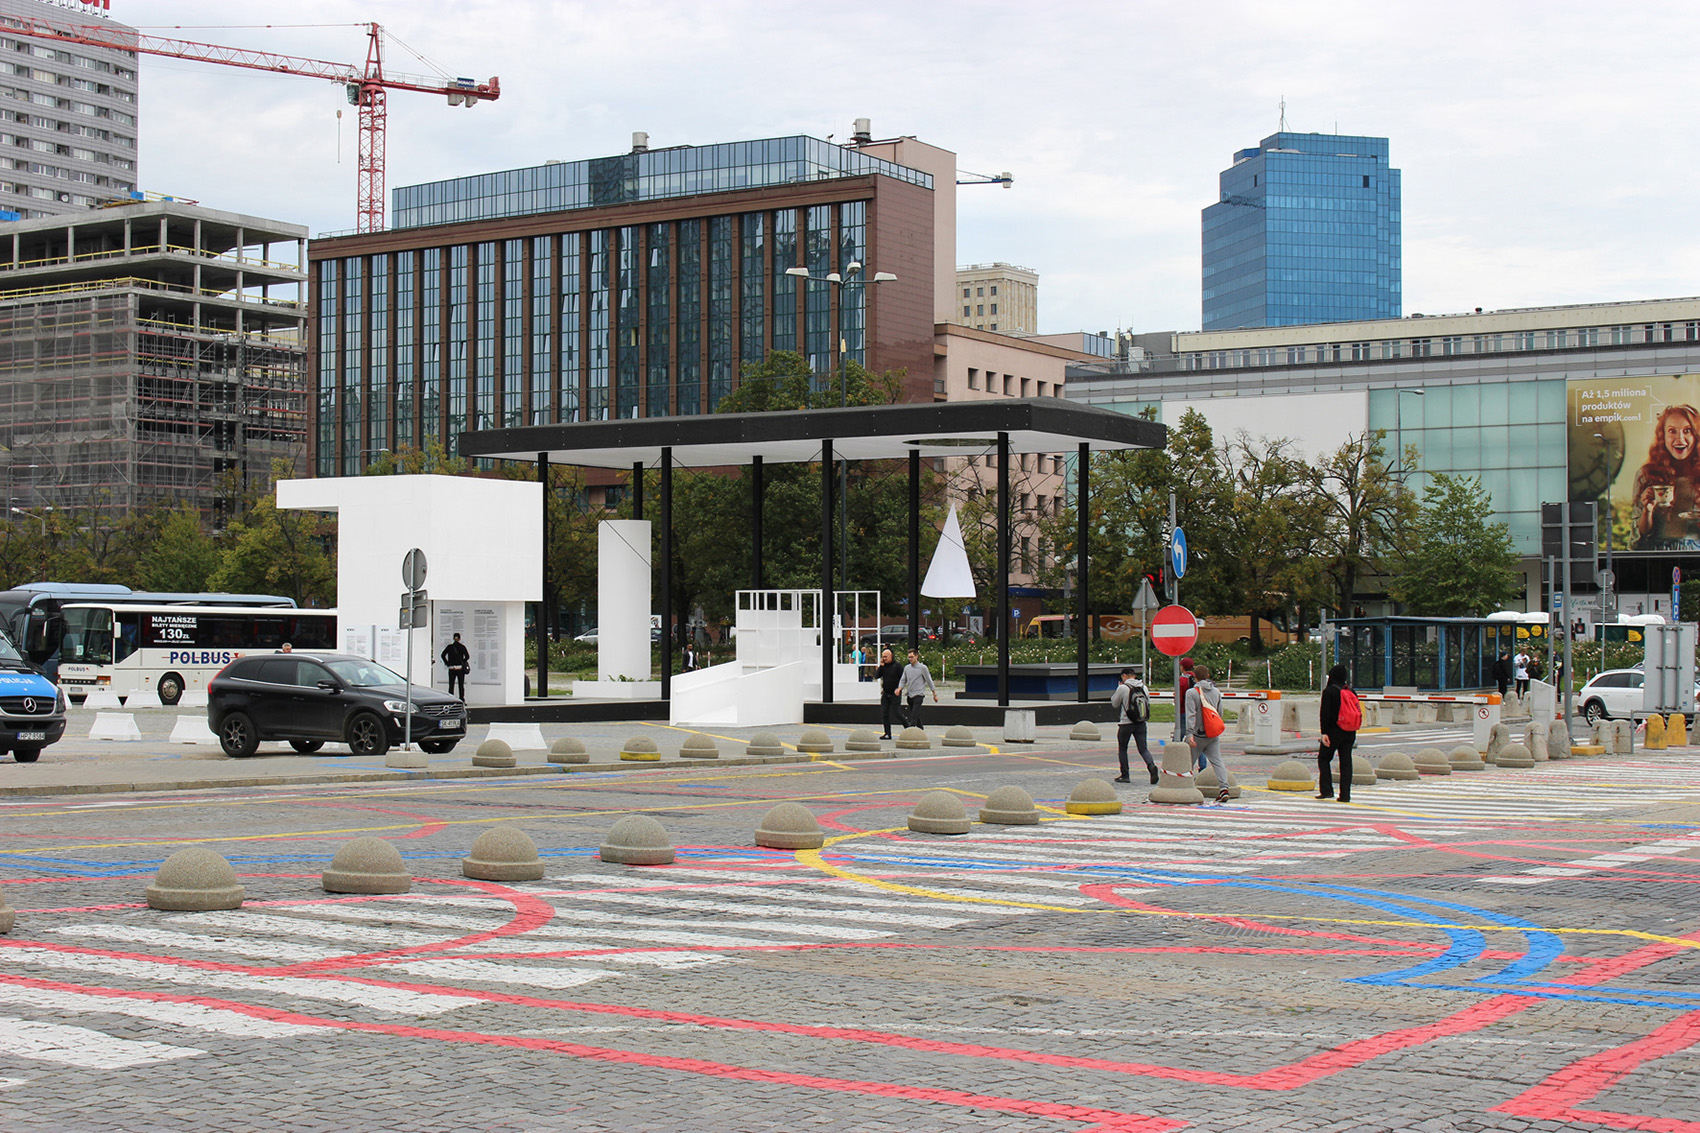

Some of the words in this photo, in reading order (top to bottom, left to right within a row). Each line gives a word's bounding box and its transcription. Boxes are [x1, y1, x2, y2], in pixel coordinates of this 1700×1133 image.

[1581, 389, 1594, 399] Aż
[1596, 389, 1610, 399] 1,5
[1611, 388, 1647, 397] miliona
[1581, 400, 1631, 412] produktów
[1594, 411, 1641, 424] empik.com!
[159, 628, 183, 639] 130
[170, 651, 231, 664] POLBUS
